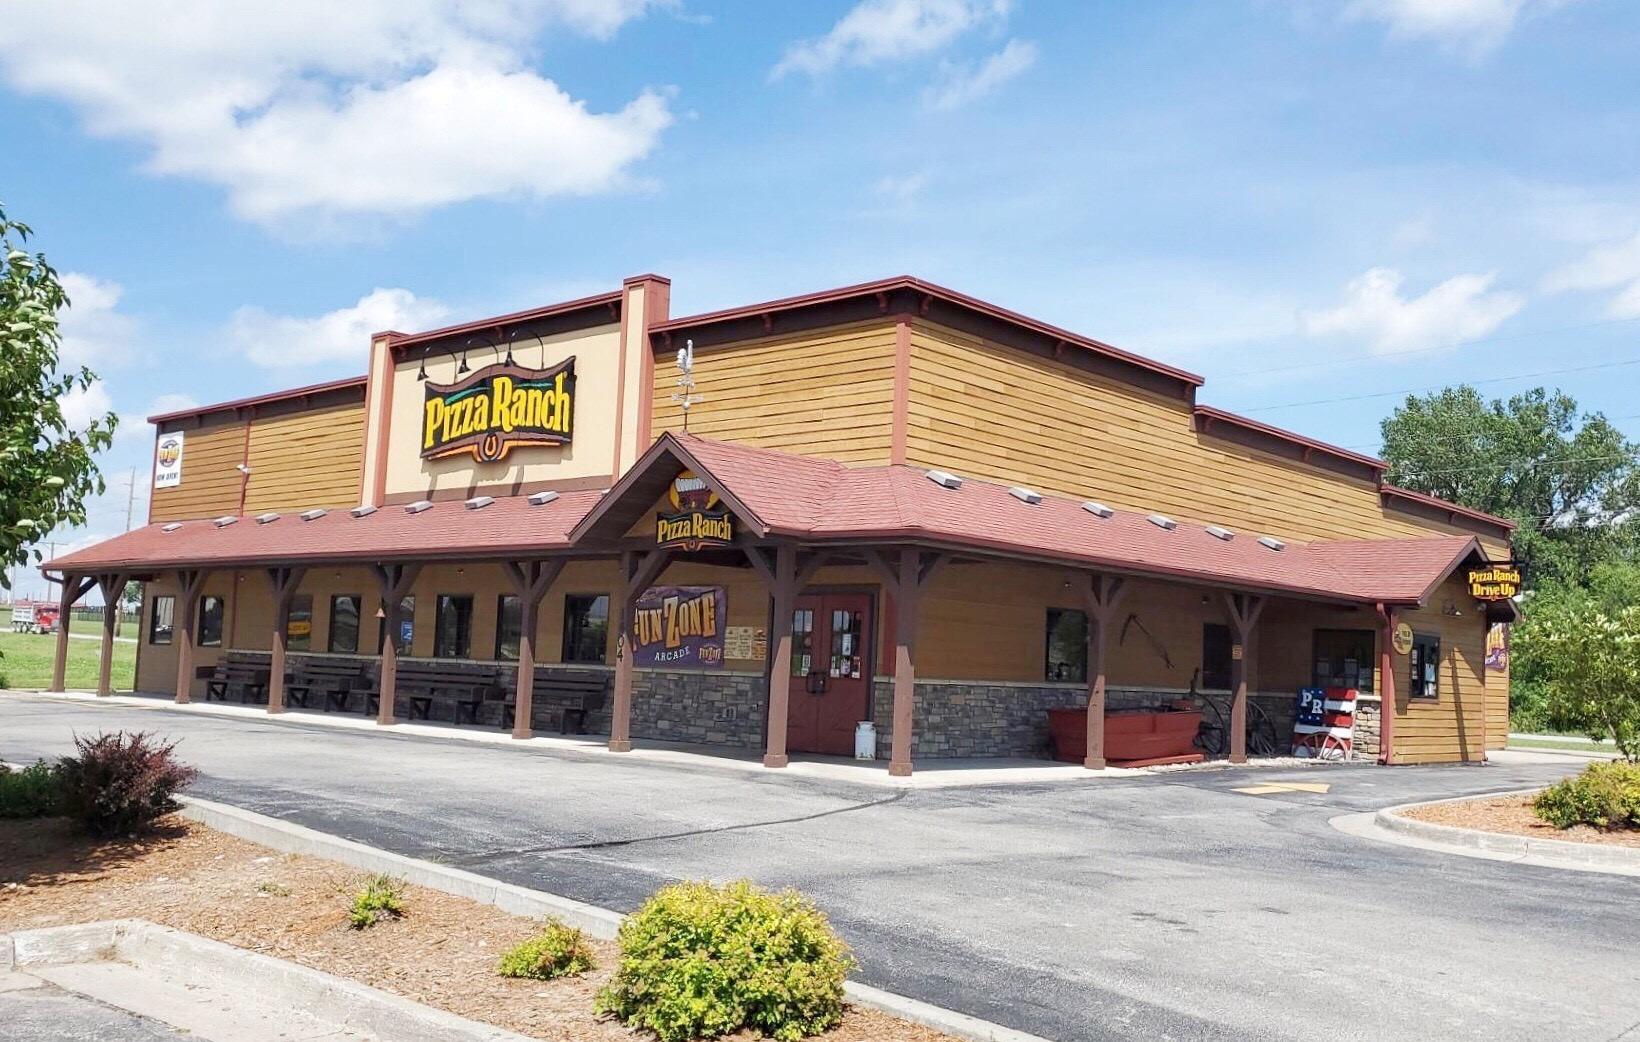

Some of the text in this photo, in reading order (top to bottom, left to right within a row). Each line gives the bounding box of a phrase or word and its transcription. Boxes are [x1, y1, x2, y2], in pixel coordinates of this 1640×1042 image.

[424, 371, 570, 449] Pizza Ranch
[657, 512, 731, 544] Pizza Ranch
[1469, 569, 1520, 583] Pizza Ranch
[1473, 583, 1515, 598] Drive Up
[664, 591, 715, 648] ZONE
[654, 645, 691, 662] ARCADE
